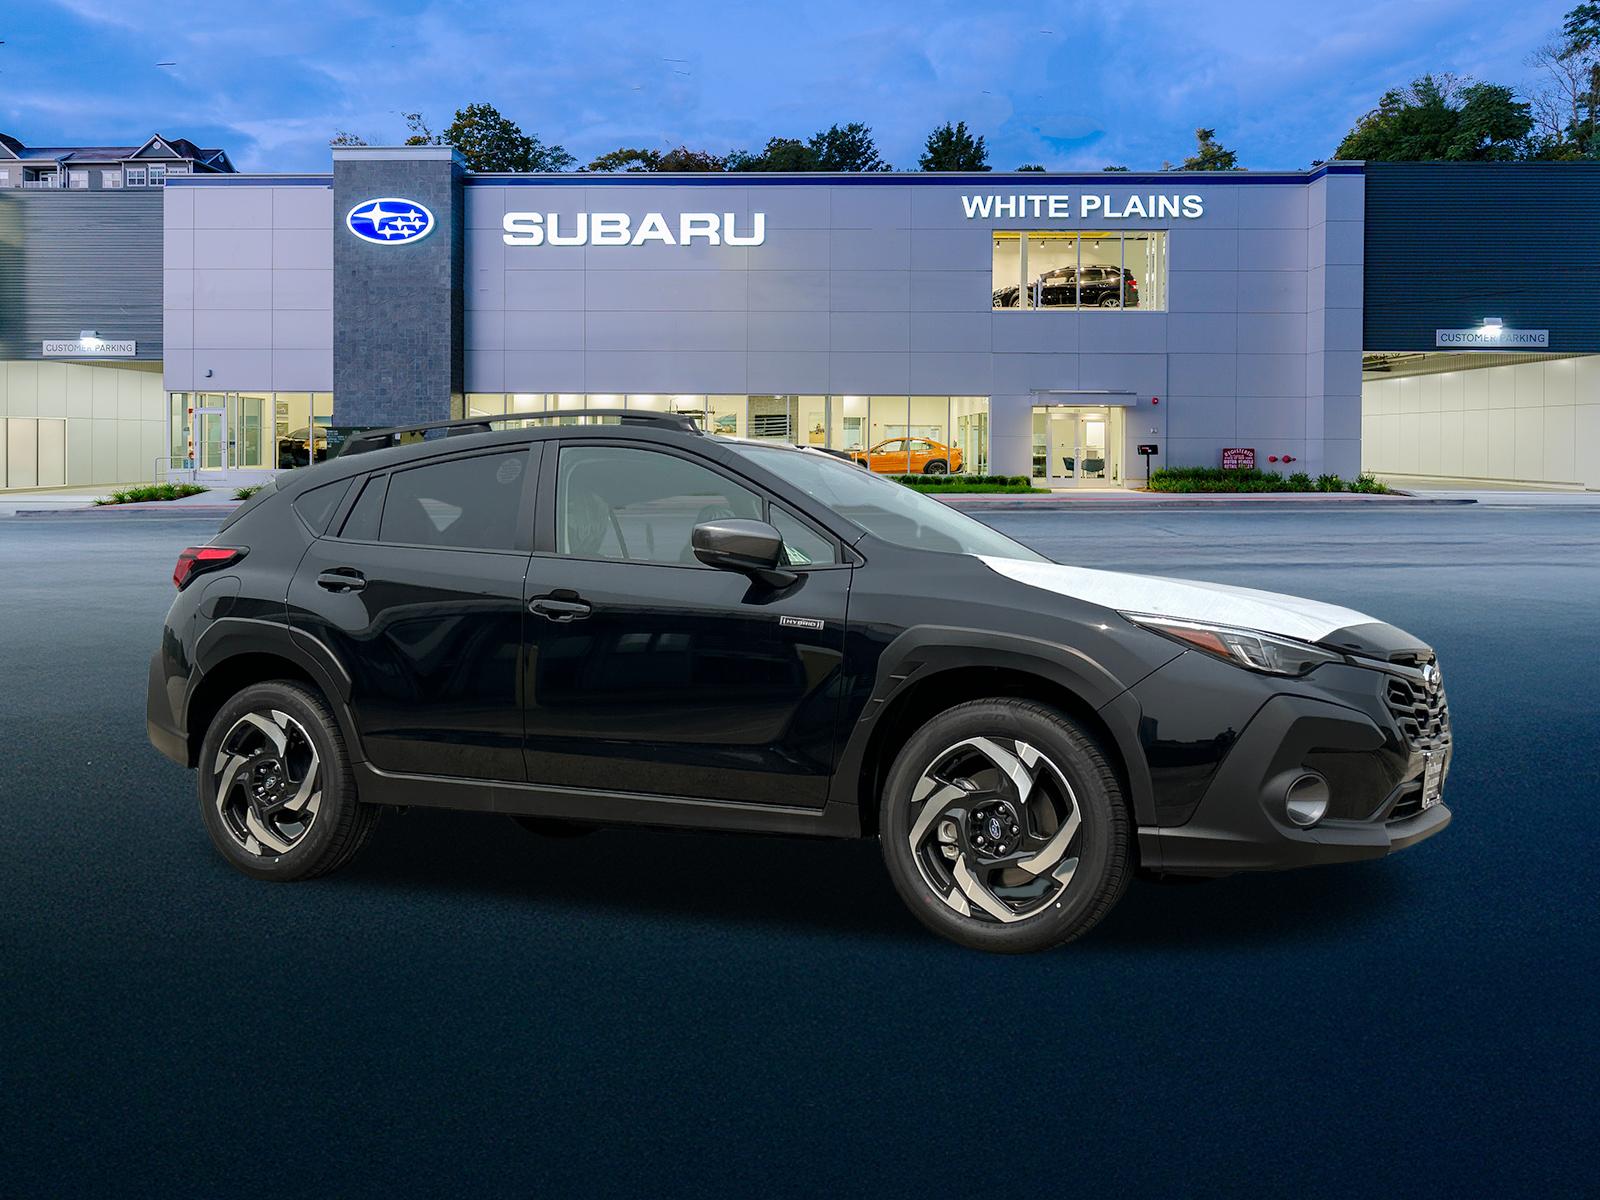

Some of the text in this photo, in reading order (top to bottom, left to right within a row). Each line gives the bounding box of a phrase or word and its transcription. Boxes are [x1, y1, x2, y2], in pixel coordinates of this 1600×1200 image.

[961, 195, 1204, 218] WHITE PLAINS
[502, 212, 765, 246] SUBARU
[1440, 333, 1545, 343] CUSTOMER PARKING
[95, 344, 133, 352] PARKING
[786, 619, 816, 627] HYBRID
